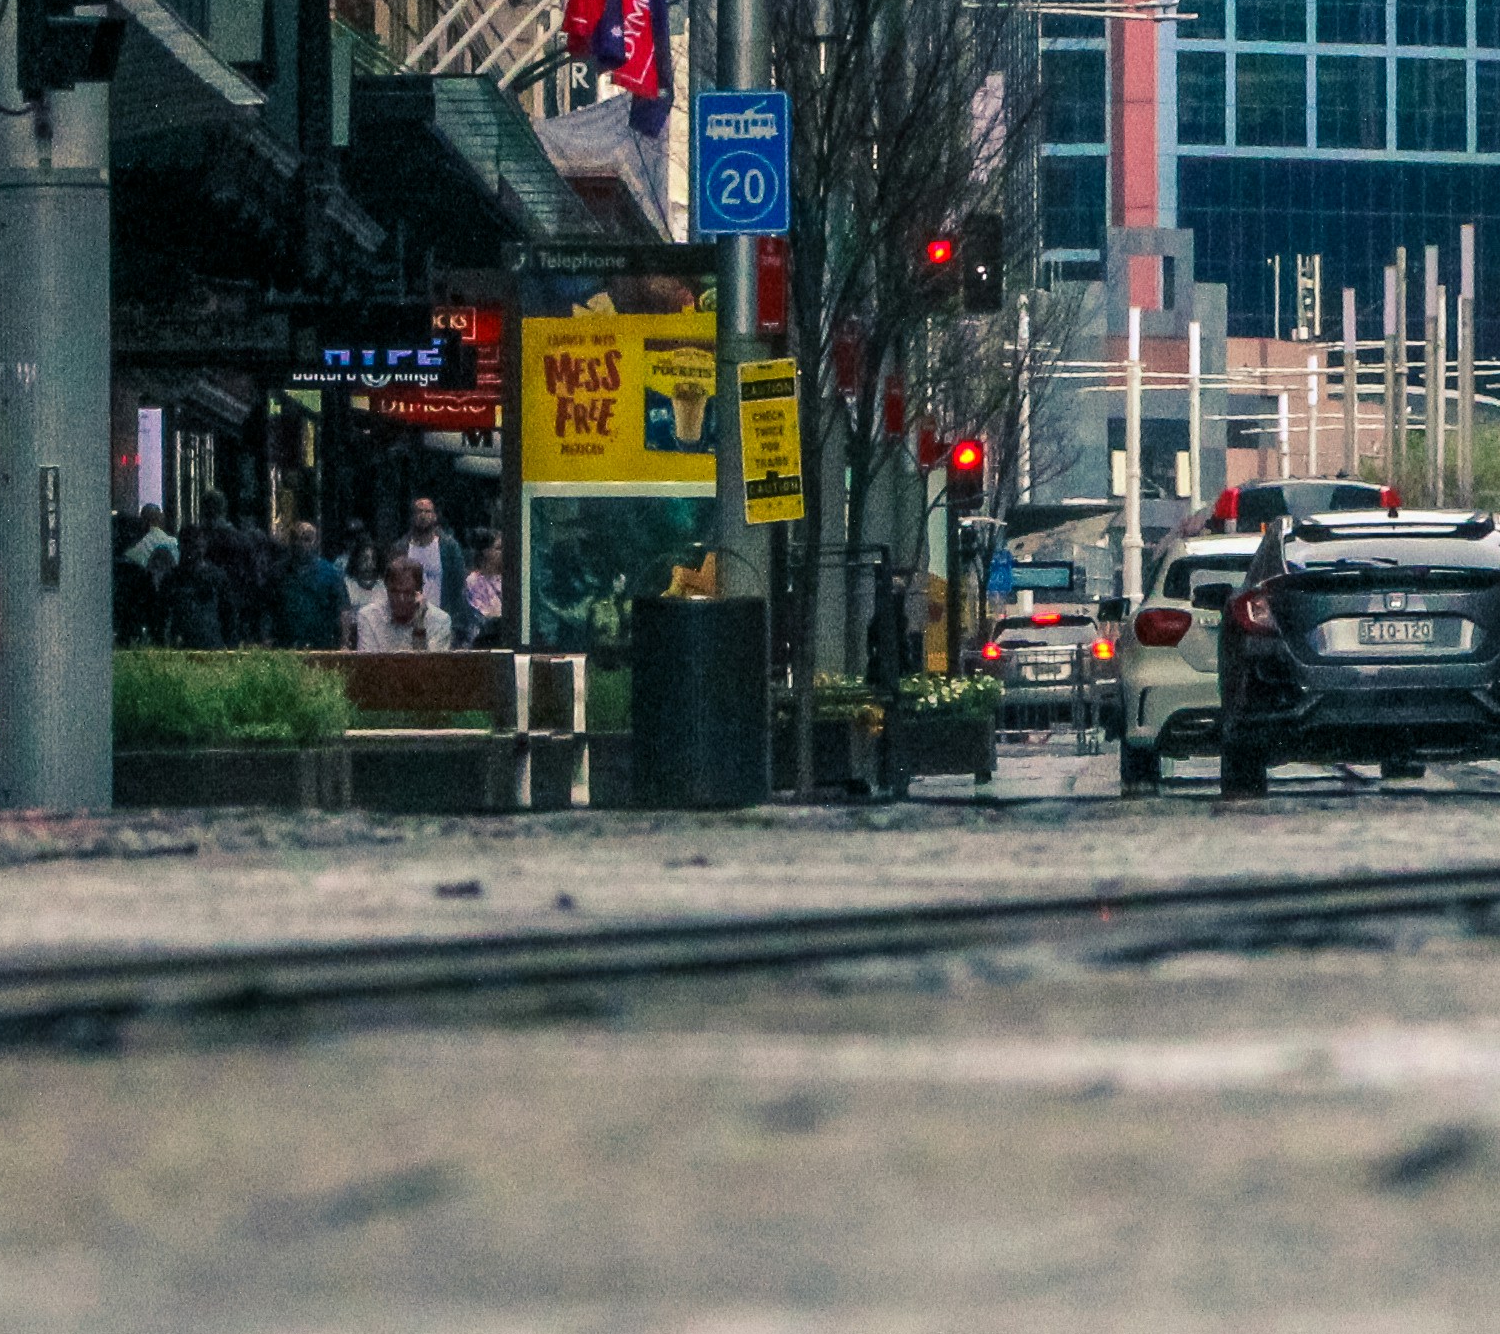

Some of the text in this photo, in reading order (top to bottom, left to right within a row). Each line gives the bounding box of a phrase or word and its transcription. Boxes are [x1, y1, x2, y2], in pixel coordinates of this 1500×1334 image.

[720, 168, 766, 206] 20
[540, 251, 627, 271] Telephone
[543, 349, 622, 396] MESS
[652, 365, 712, 378] POCKETS
[555, 397, 616, 438] FREE
